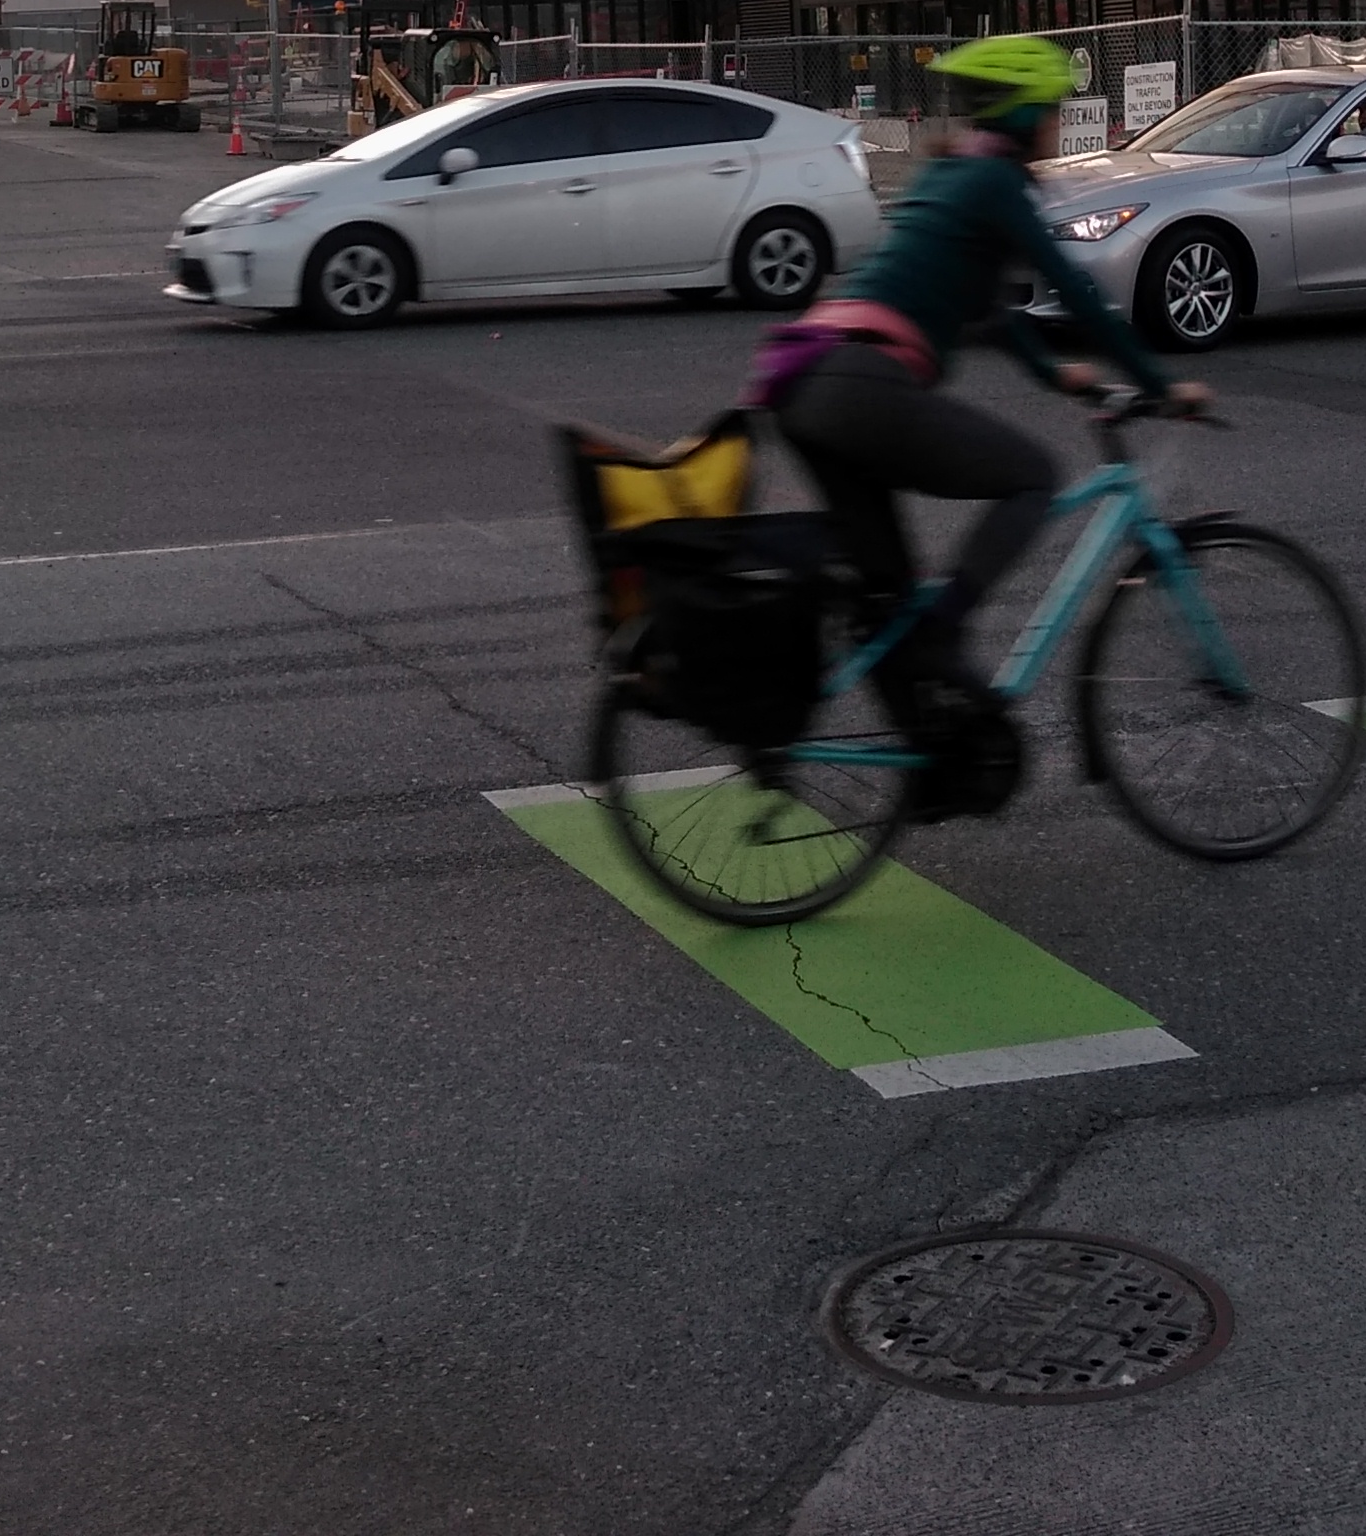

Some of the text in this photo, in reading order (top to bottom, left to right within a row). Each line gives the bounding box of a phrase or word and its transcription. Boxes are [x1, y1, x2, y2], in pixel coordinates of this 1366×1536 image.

[133, 60, 161, 78] CAT
[1126, 72, 1175, 86] CONSTRUCTION
[1135, 86, 1162, 98] TRAFFIC
[1128, 99, 1172, 113] ONLY BEYOND
[1061, 105, 1105, 126] SIDEWALK
[1132, 114, 1146, 125] THIS
[1062, 136, 1104, 156] CLOSED
